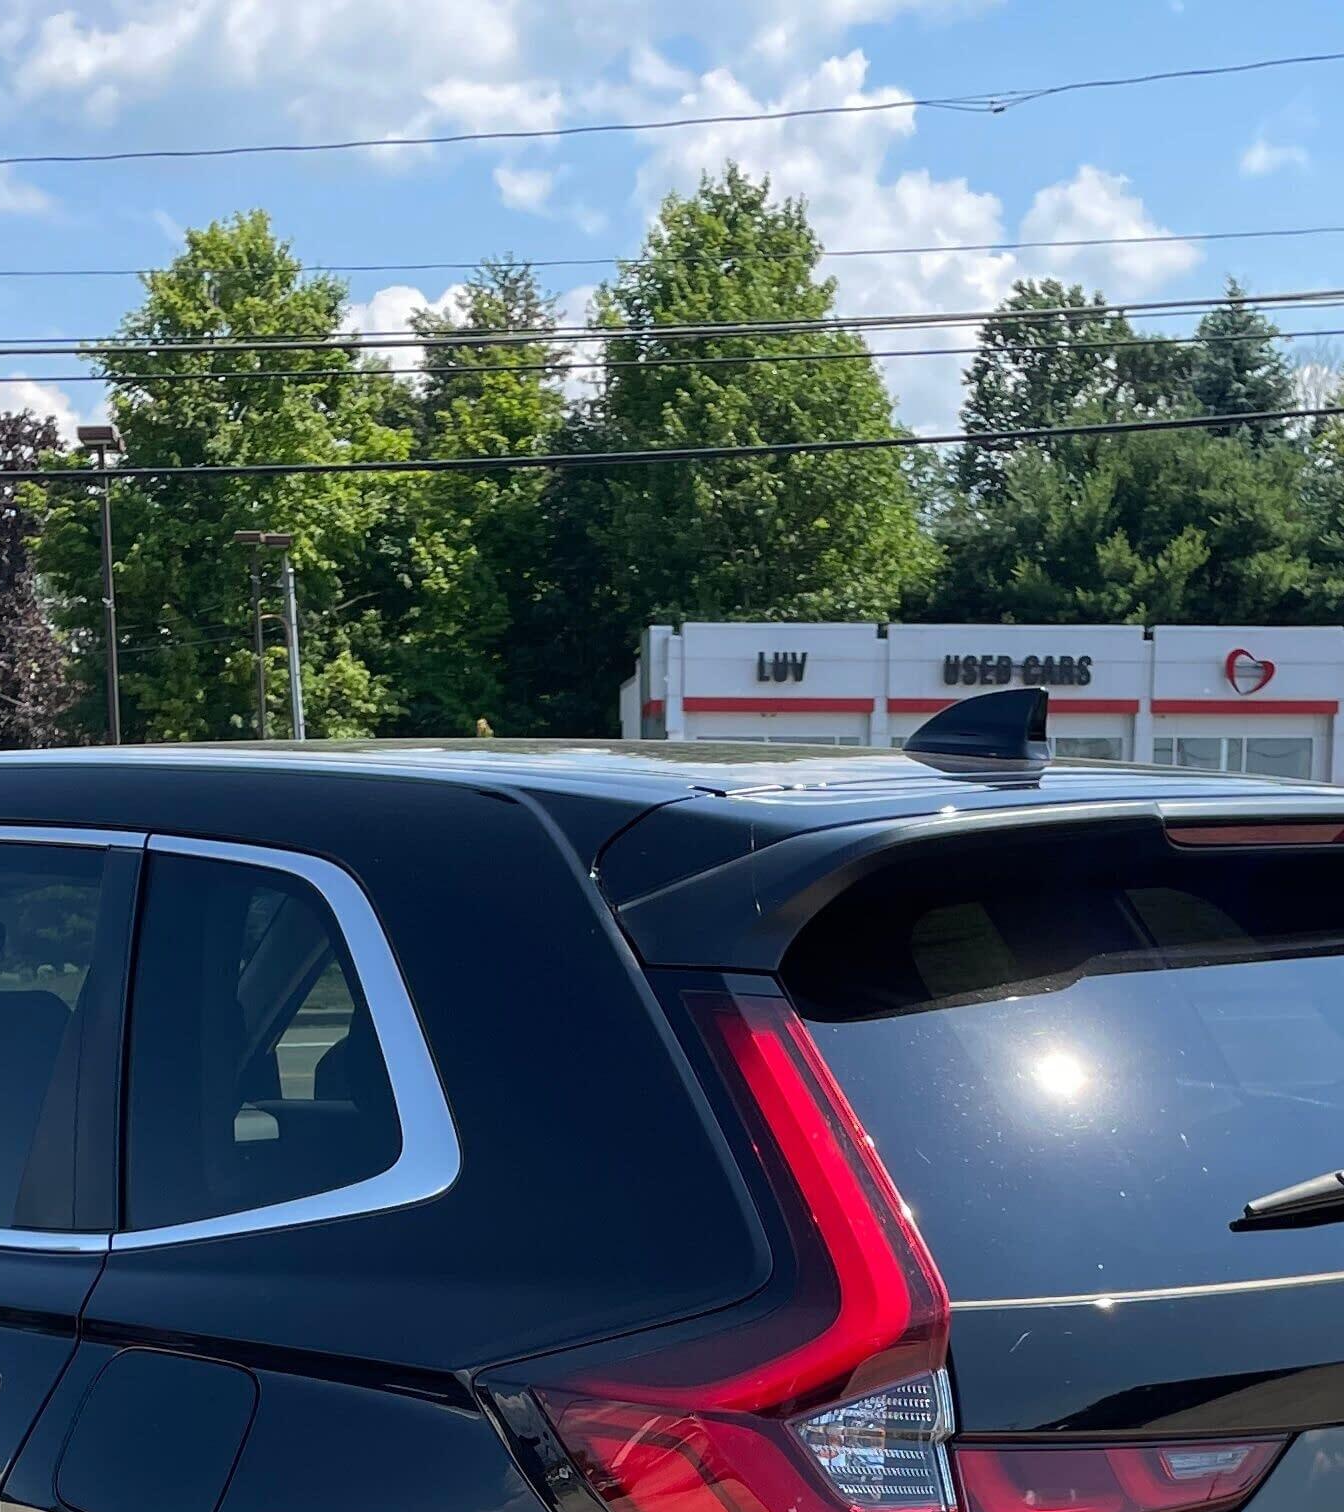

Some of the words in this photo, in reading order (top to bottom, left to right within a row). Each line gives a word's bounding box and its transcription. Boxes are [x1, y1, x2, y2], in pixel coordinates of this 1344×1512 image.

[757, 651, 808, 682] LUV
[944, 654, 1012, 685] USED
[1023, 654, 1093, 686] CARS
